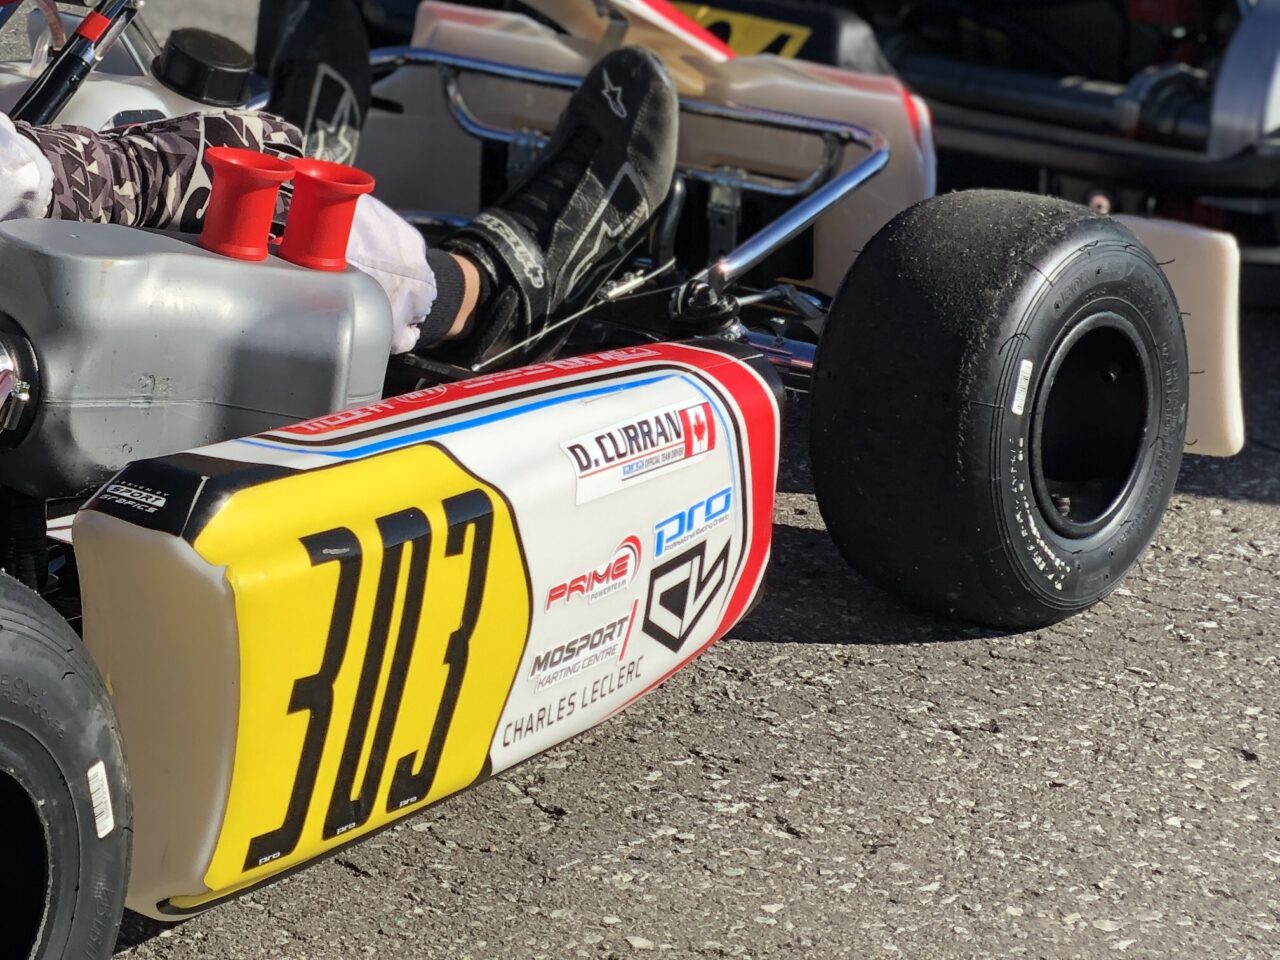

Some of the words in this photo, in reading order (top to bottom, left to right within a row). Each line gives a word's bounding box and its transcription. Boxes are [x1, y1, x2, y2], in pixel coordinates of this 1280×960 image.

[110, 485, 163, 504] SPORT
[654, 486, 733, 558] pro
[546, 553, 631, 611] PRIME
[530, 615, 629, 677] MOSPORT
[537, 660, 581, 688] KARTING
[581, 643, 619, 670] CENTRE
[241, 488, 494, 873] 303
[502, 691, 577, 748] CHARLES
[581, 655, 644, 710] LECLERC
[398, 795, 418, 808] pro
[336, 821, 356, 835] pro
[258, 850, 281, 866] pro
